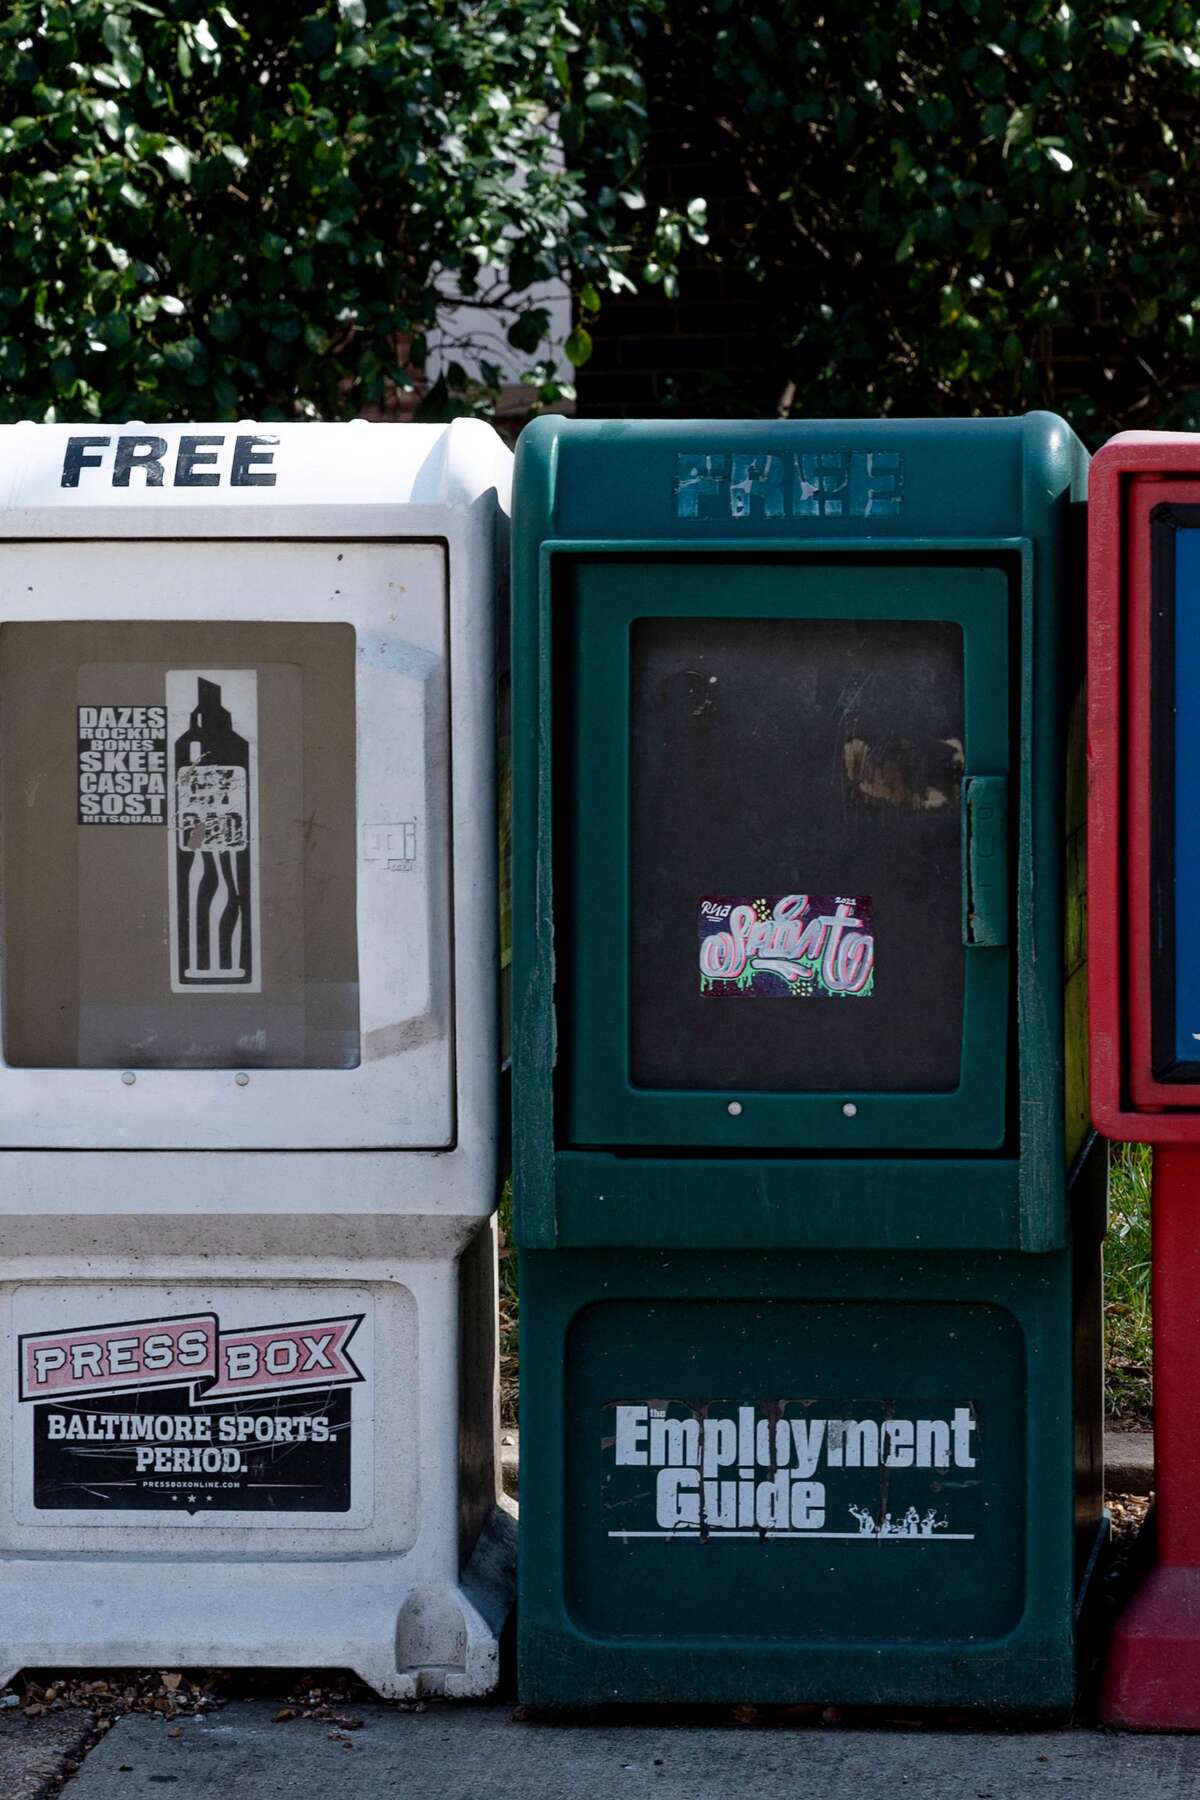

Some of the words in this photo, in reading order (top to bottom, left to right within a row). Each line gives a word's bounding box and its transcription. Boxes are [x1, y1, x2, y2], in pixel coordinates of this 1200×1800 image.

[61, 436, 281, 488] FREE
[677, 453, 901, 517] FREE
[80, 706, 165, 728] DAZES
[80, 728, 165, 740] ROCKIN
[91, 740, 154, 751] BONES
[80, 752, 166, 772] SKEE
[80, 773, 166, 793] CASPA
[80, 794, 166, 815] SOST
[83, 815, 163, 824] HITSQUAD
[34, 1330, 209, 1384] PRESS
[226, 1333, 336, 1382] BOX
[650, 1409, 666, 1418] the
[48, 1414, 212, 1441] BALTIMORE
[218, 1416, 338, 1443] SPORTS.
[615, 1406, 977, 1479] Employment
[136, 1447, 248, 1473] PERIOD.
[143, 1480, 241, 1489] PRESSBOXONLINE.COM
[656, 1467, 826, 1529] Guide
